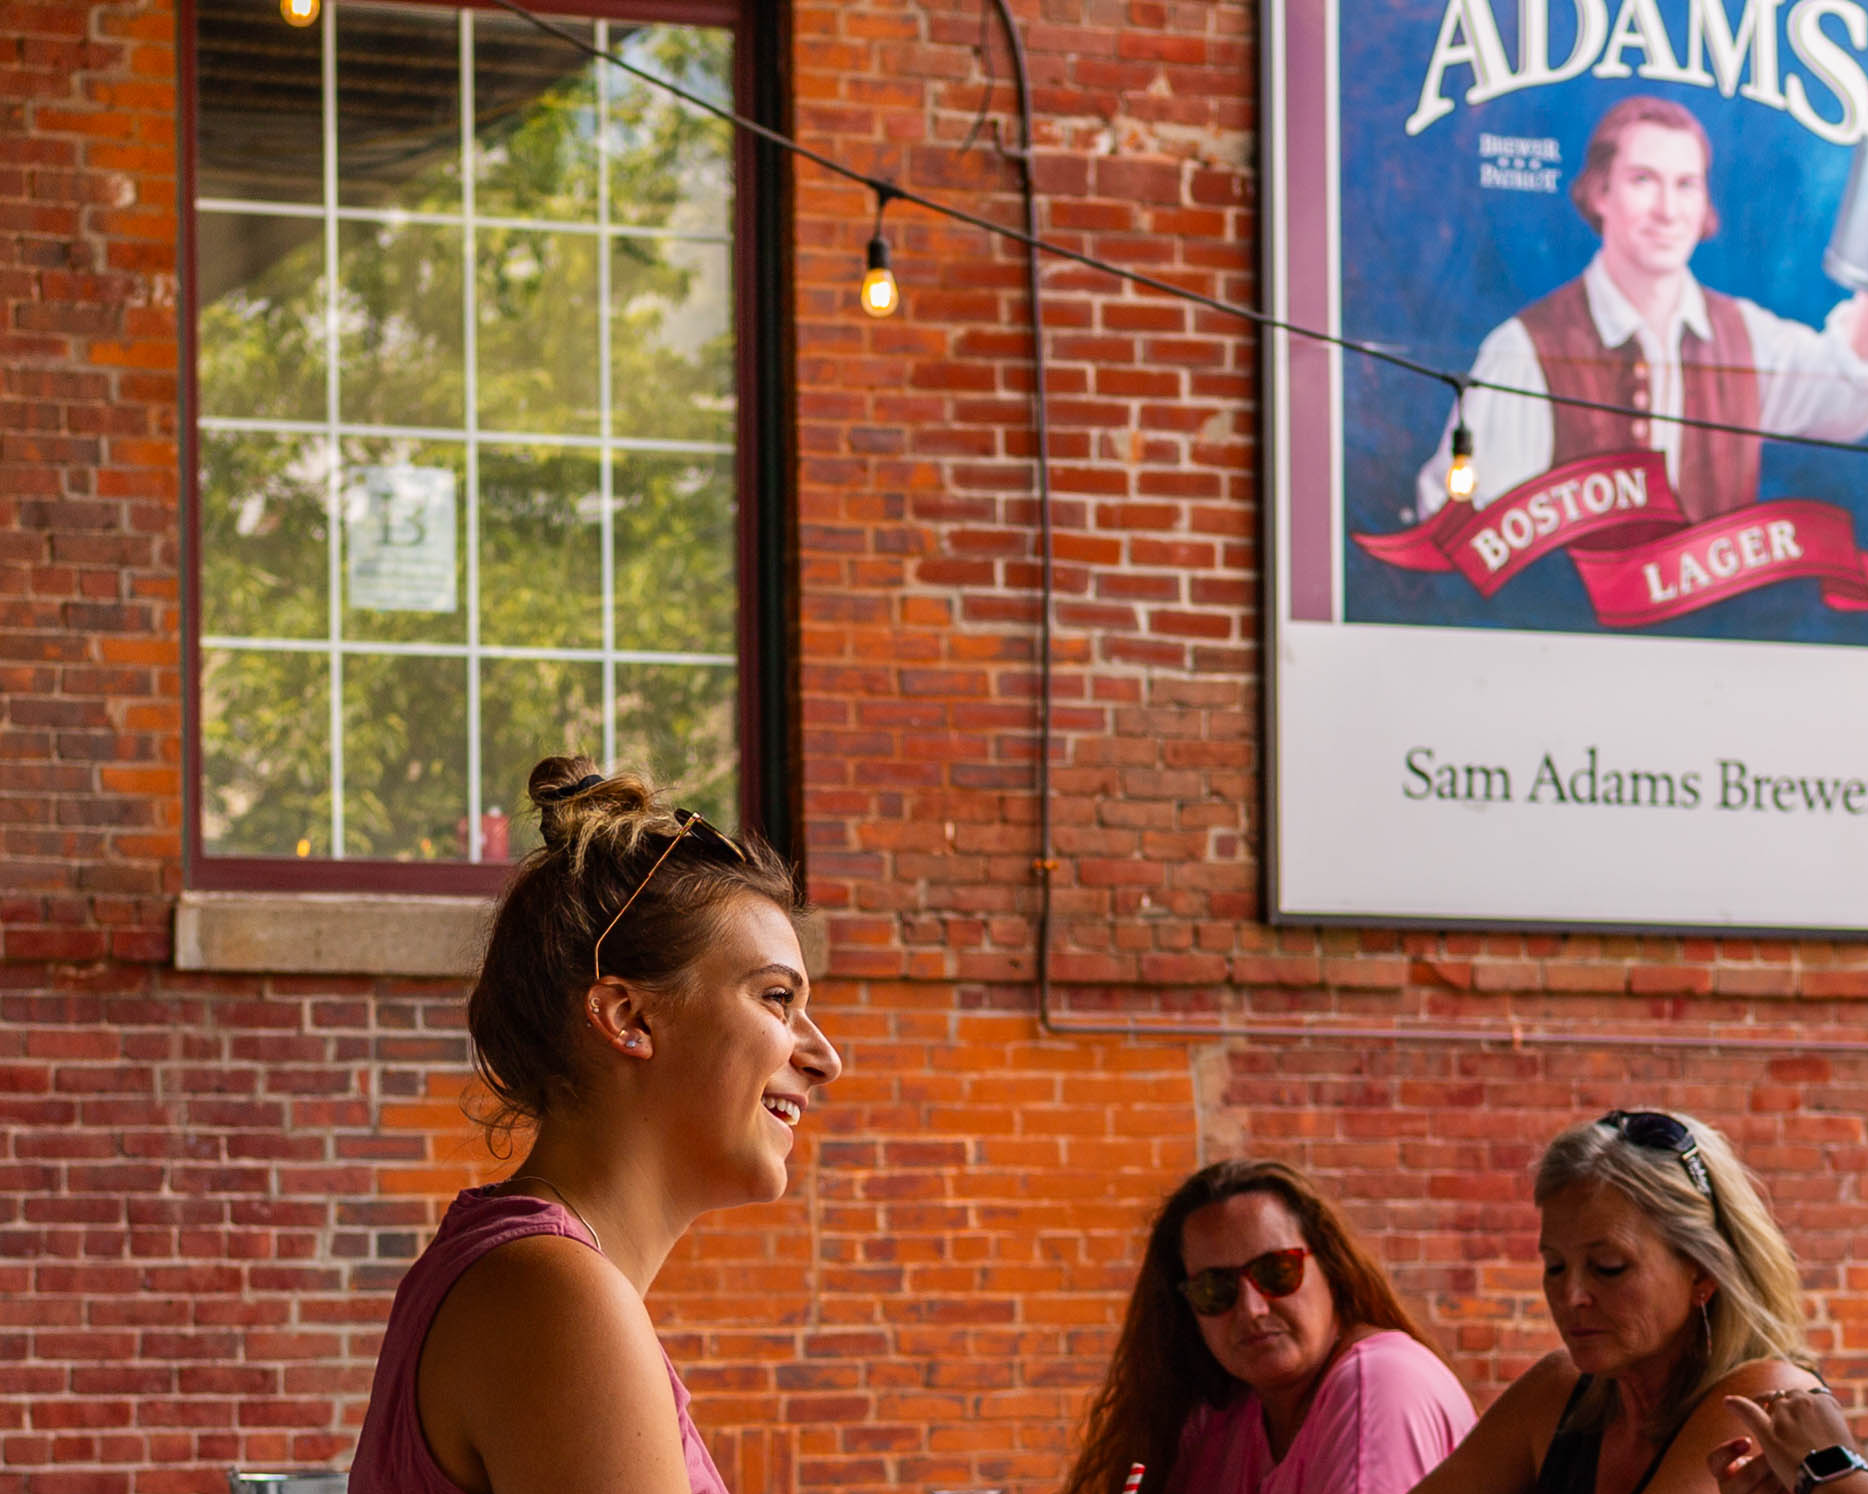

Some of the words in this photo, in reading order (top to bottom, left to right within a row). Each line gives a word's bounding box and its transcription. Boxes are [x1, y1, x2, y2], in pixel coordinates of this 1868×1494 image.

[1469, 467, 1649, 573] BOSTON
[1643, 519, 1804, 604] LAGER
[1402, 746, 1513, 803] Sam
[1527, 748, 1702, 812] Adams
